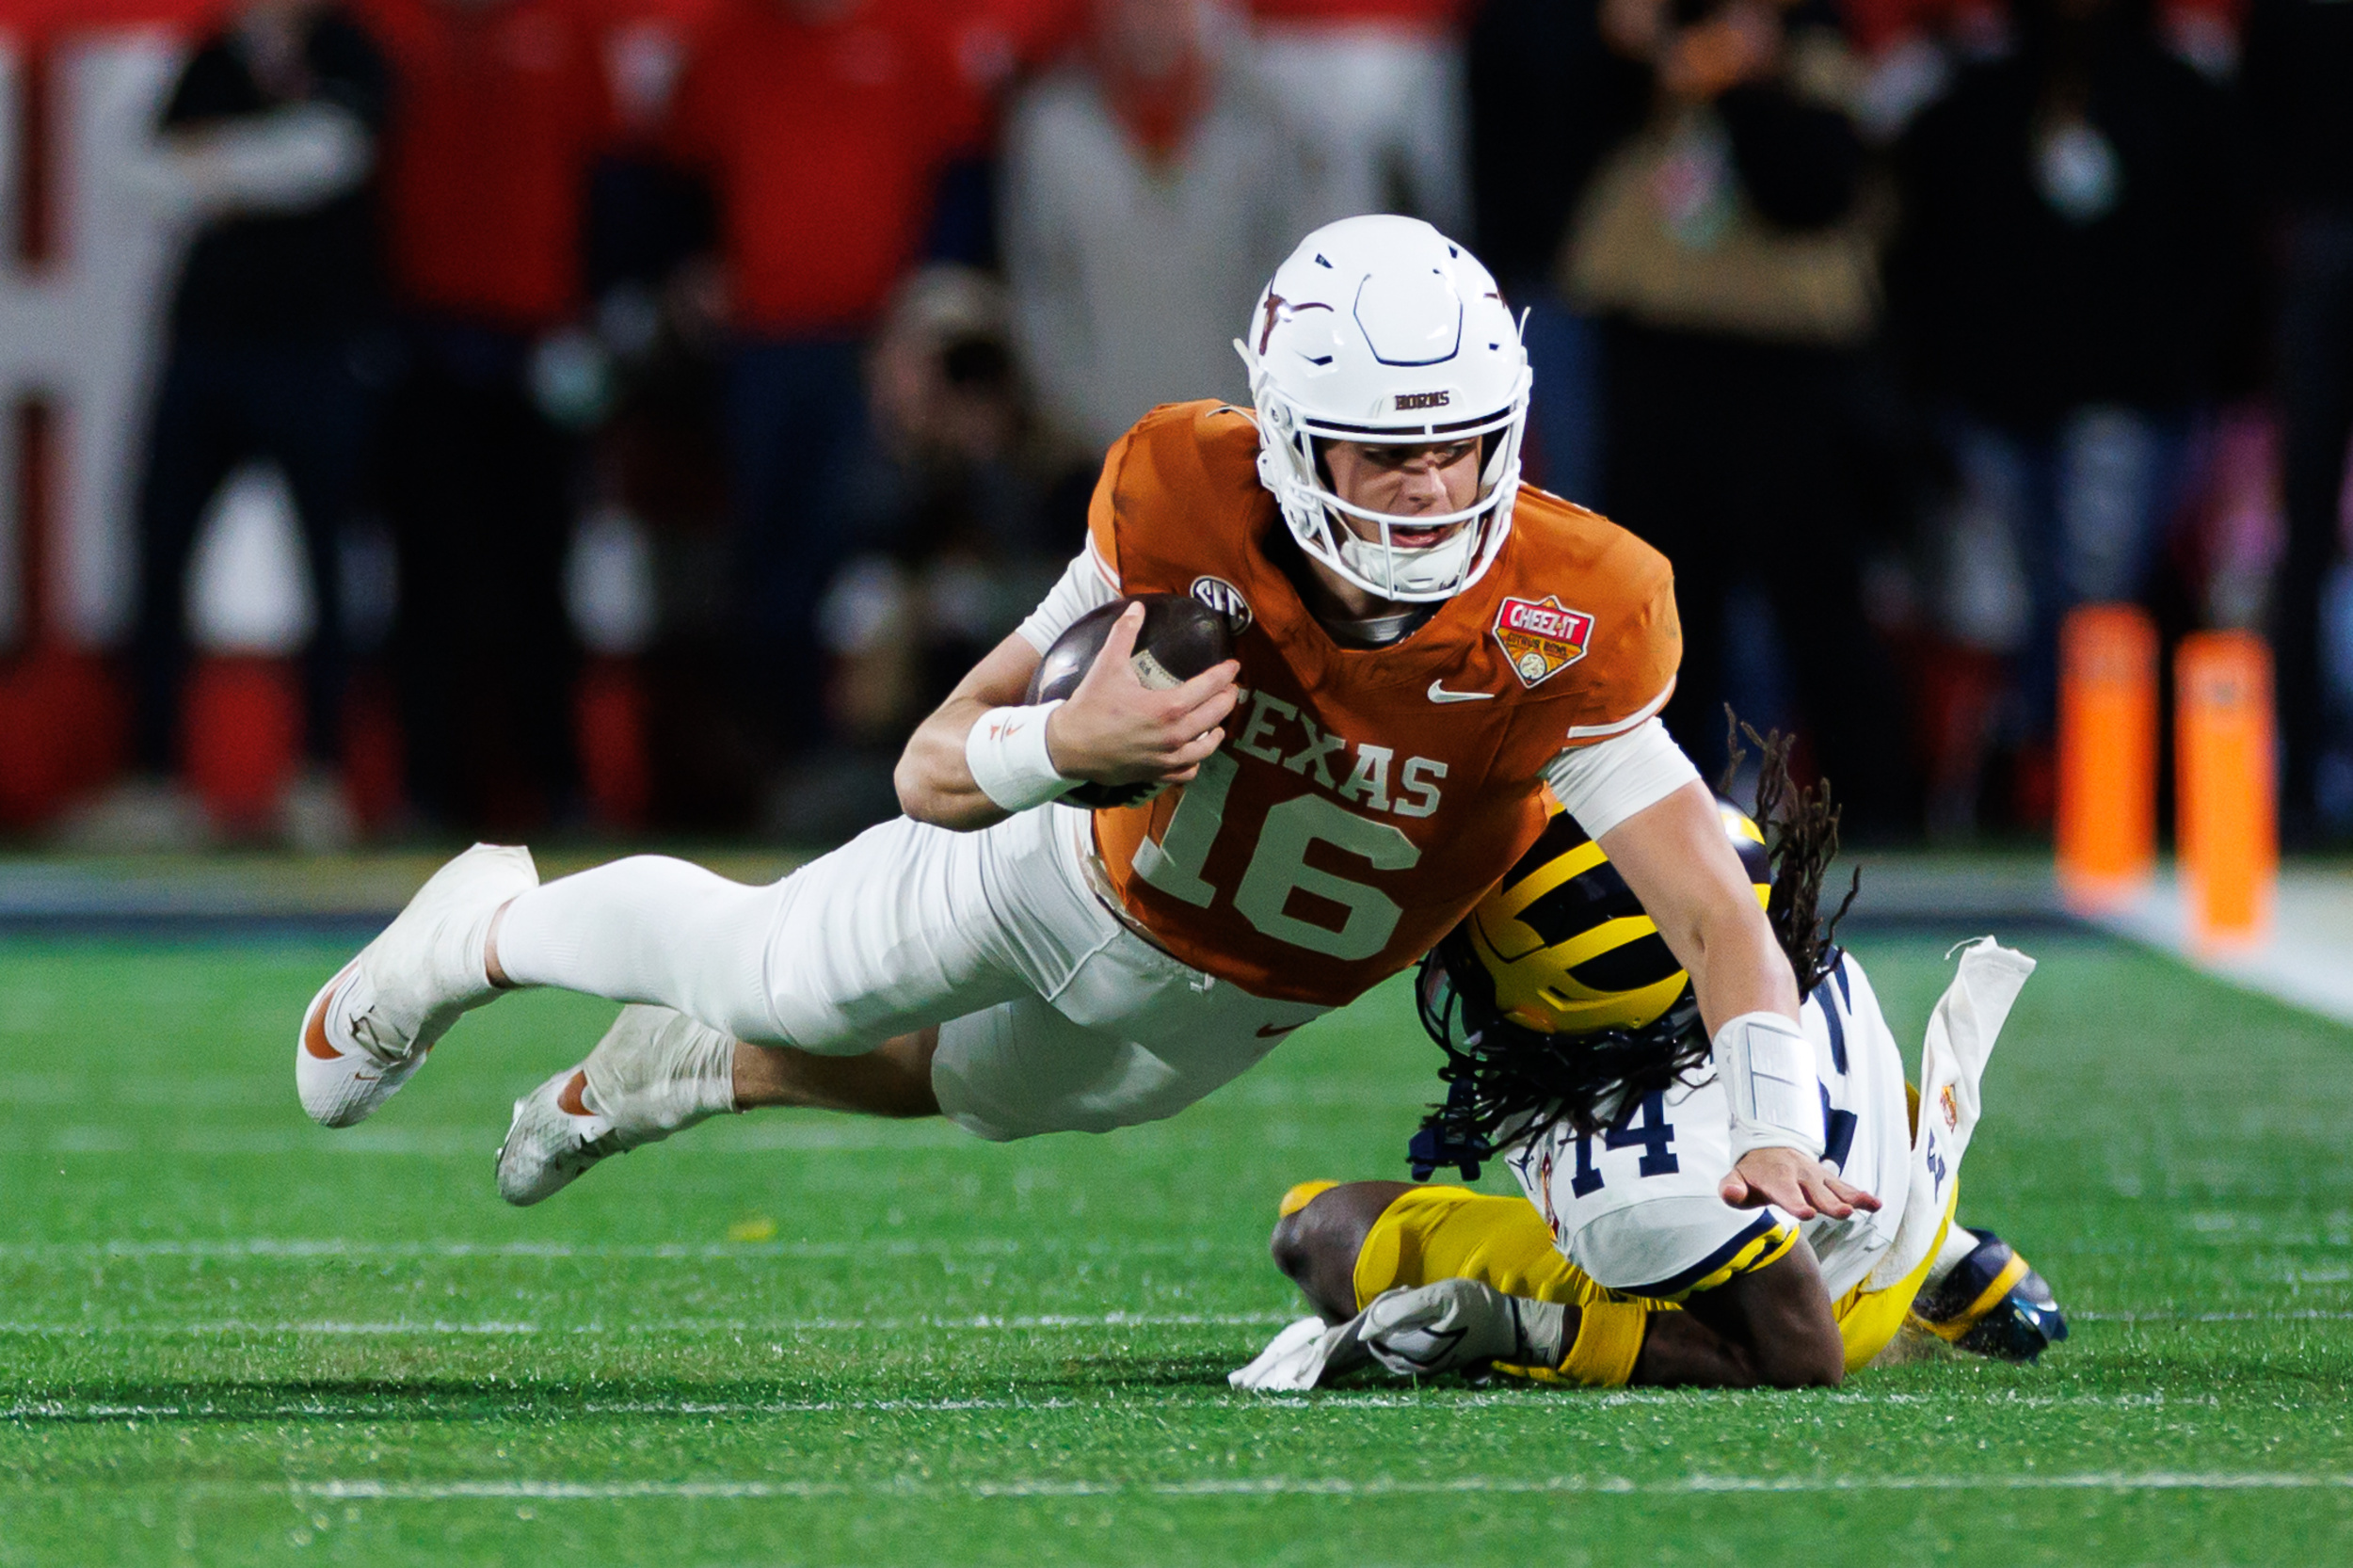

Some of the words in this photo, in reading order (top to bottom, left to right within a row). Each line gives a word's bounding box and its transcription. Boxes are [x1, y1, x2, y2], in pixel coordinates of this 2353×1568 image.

[1237, 688, 1449, 819] EXAS
[1131, 747, 1421, 962] 16
[1572, 1082, 1680, 1199] 14
